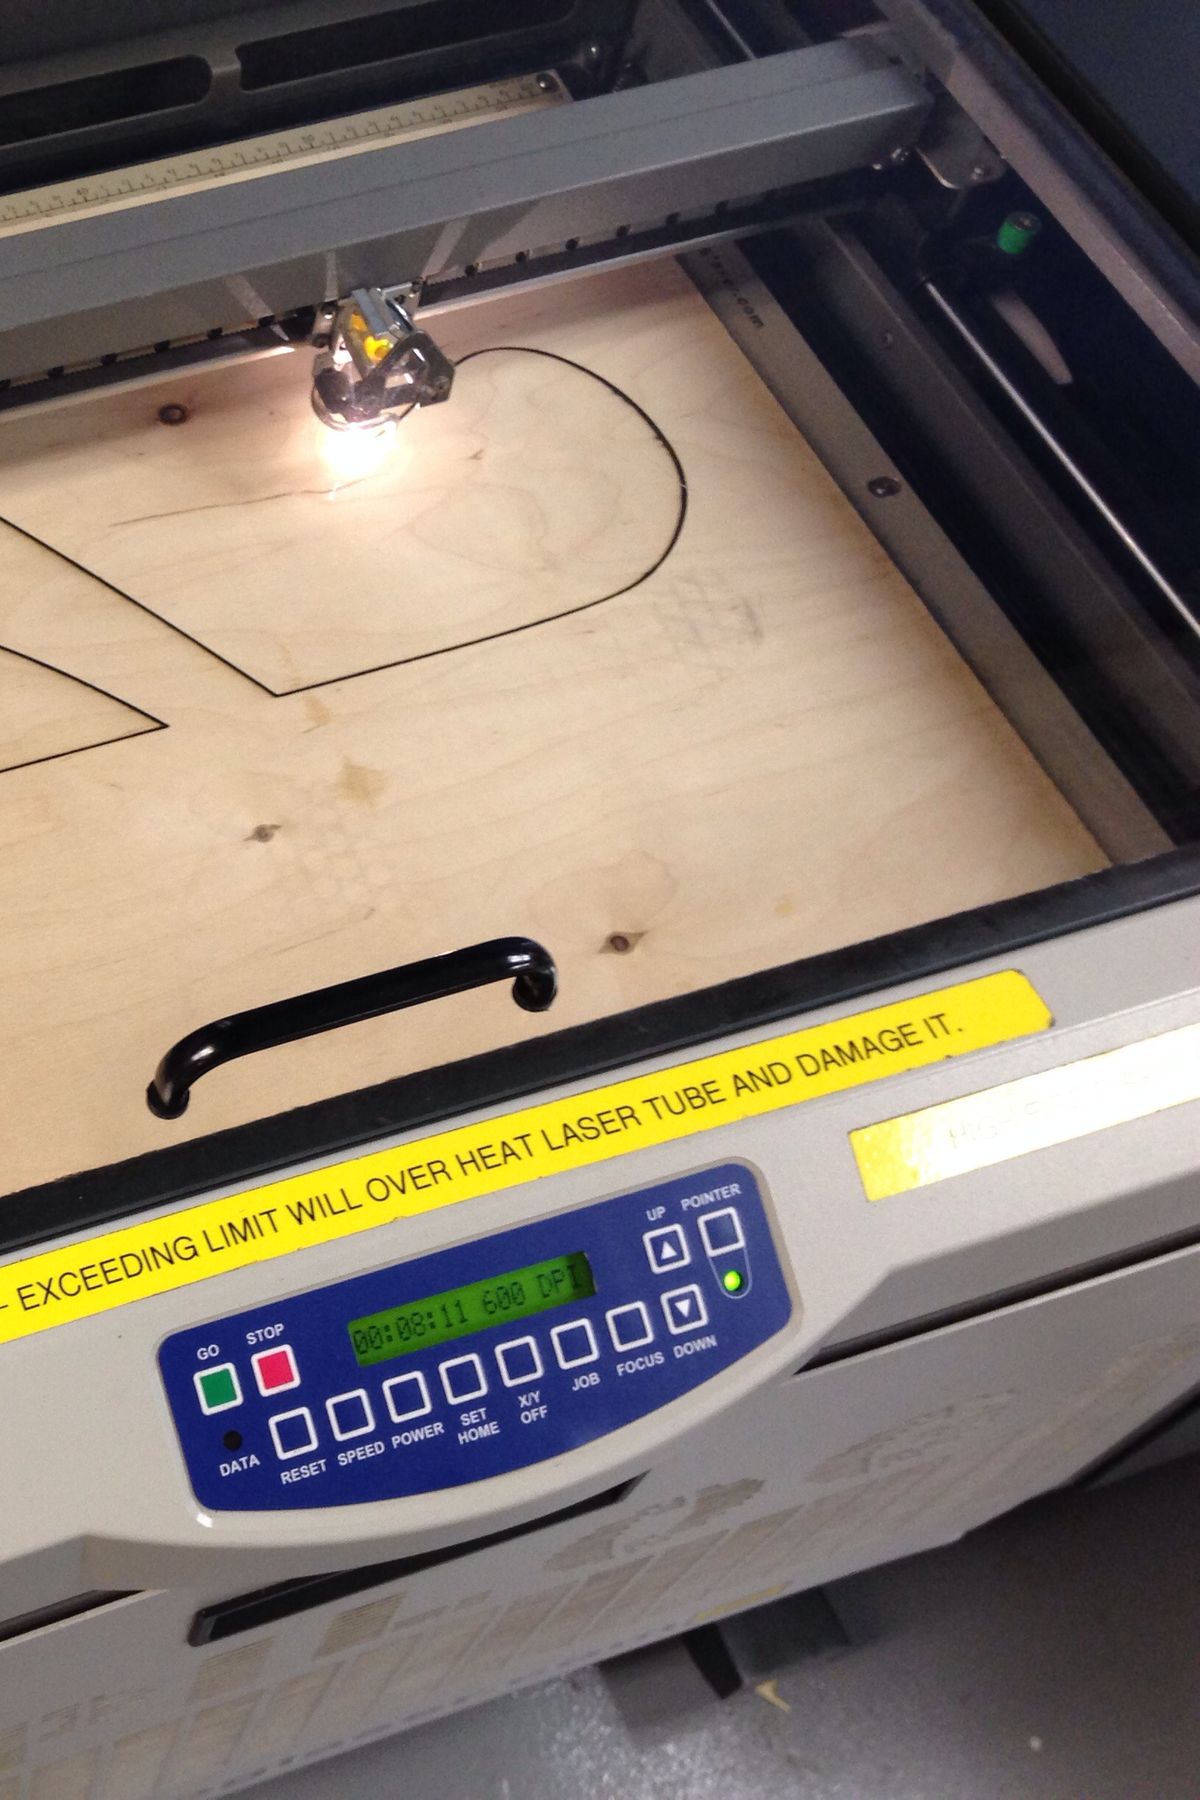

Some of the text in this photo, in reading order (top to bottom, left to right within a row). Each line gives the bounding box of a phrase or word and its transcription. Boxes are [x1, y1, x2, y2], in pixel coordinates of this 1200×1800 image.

[17, 1235, 200, 1311] EXCEEDING
[200, 1208, 280, 1253] LIMIT
[289, 1187, 363, 1226] WILL
[366, 1160, 453, 1203] OVER
[456, 1132, 535, 1175] HEAT
[545, 1105, 643, 1150] LASER
[647, 1080, 727, 1121] TUBE
[732, 1059, 794, 1095] AND
[796, 1023, 924, 1077] DAMAGE
[927, 1012, 964, 1038] IT.
[681, 1183, 742, 1211] POINTER
[646, 1205, 667, 1222] UP
[352, 1264, 583, 1355] 00:08:11 600 DPI
[246, 1323, 285, 1346] STOP
[197, 1343, 220, 1361] GO
[673, 1335, 717, 1360] DOWN
[616, 1351, 665, 1378] FOCUS
[572, 1373, 600, 1393] JOB
[519, 1391, 541, 1409] X/Y
[461, 1408, 487, 1427] SET
[520, 1406, 548, 1425] OFF
[391, 1421, 445, 1450] POWER
[457, 1421, 500, 1446] HOME
[219, 1453, 260, 1477] DATA
[337, 1441, 386, 1467] SPEED
[280, 1459, 328, 1485] RESET
